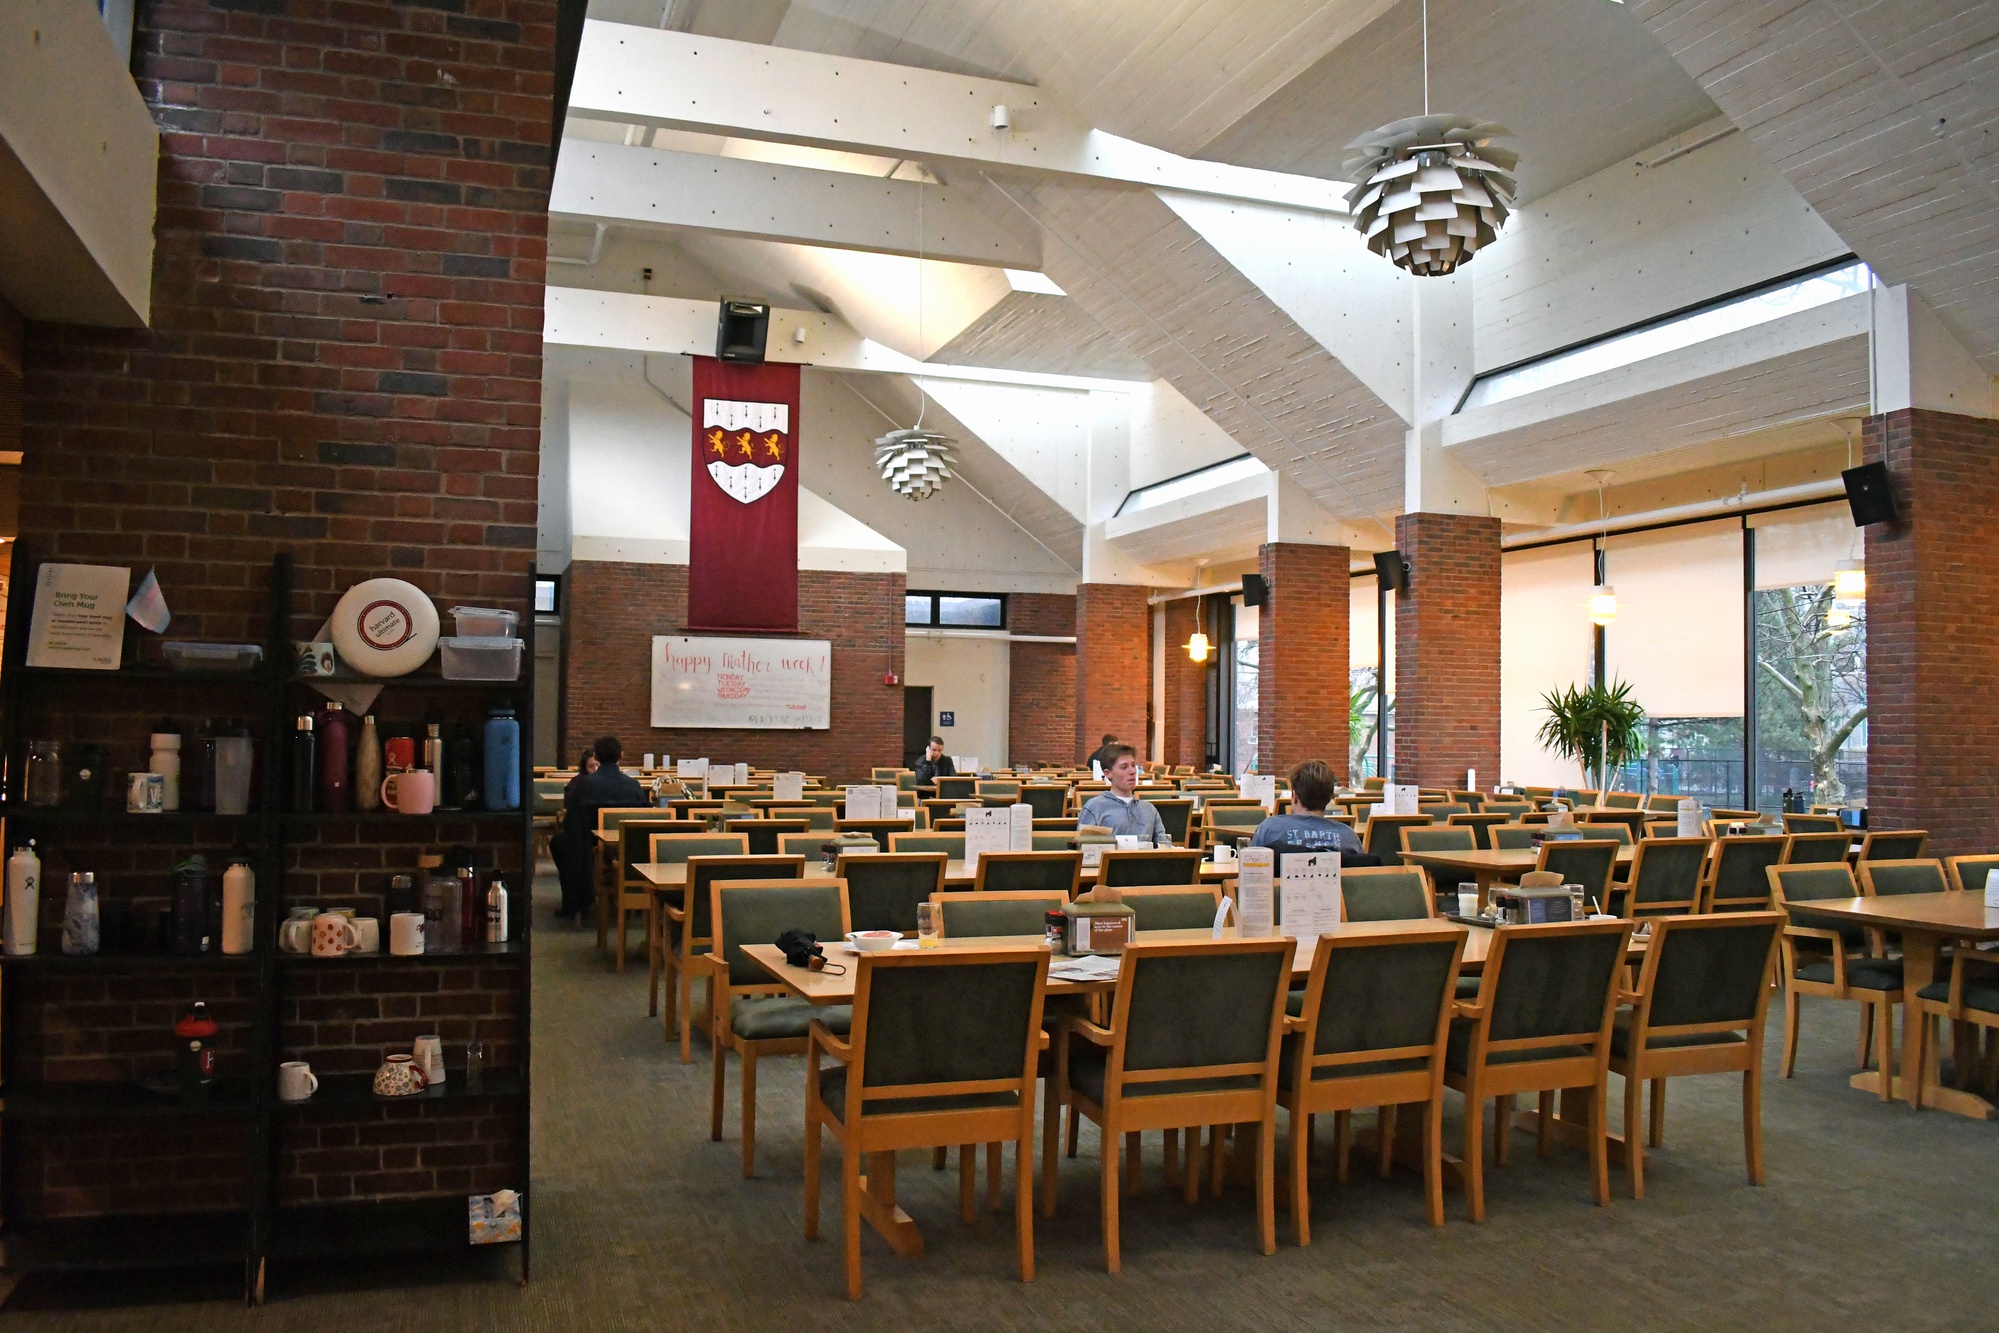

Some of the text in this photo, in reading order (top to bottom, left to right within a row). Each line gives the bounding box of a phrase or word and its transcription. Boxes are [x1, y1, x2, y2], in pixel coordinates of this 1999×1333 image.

[55, 592, 98, 601] Bring Your
[76, 601, 96, 610] Mug
[369, 611, 396, 632] harvard
[376, 618, 401, 638] ultimate
[666, 642, 712, 673] happy
[717, 673, 745, 681] MONDAY
[717, 680, 747, 688] TUESDAY
[717, 692, 748, 700] THURSDAY
[1286, 830, 1340, 842] ST BARTH
